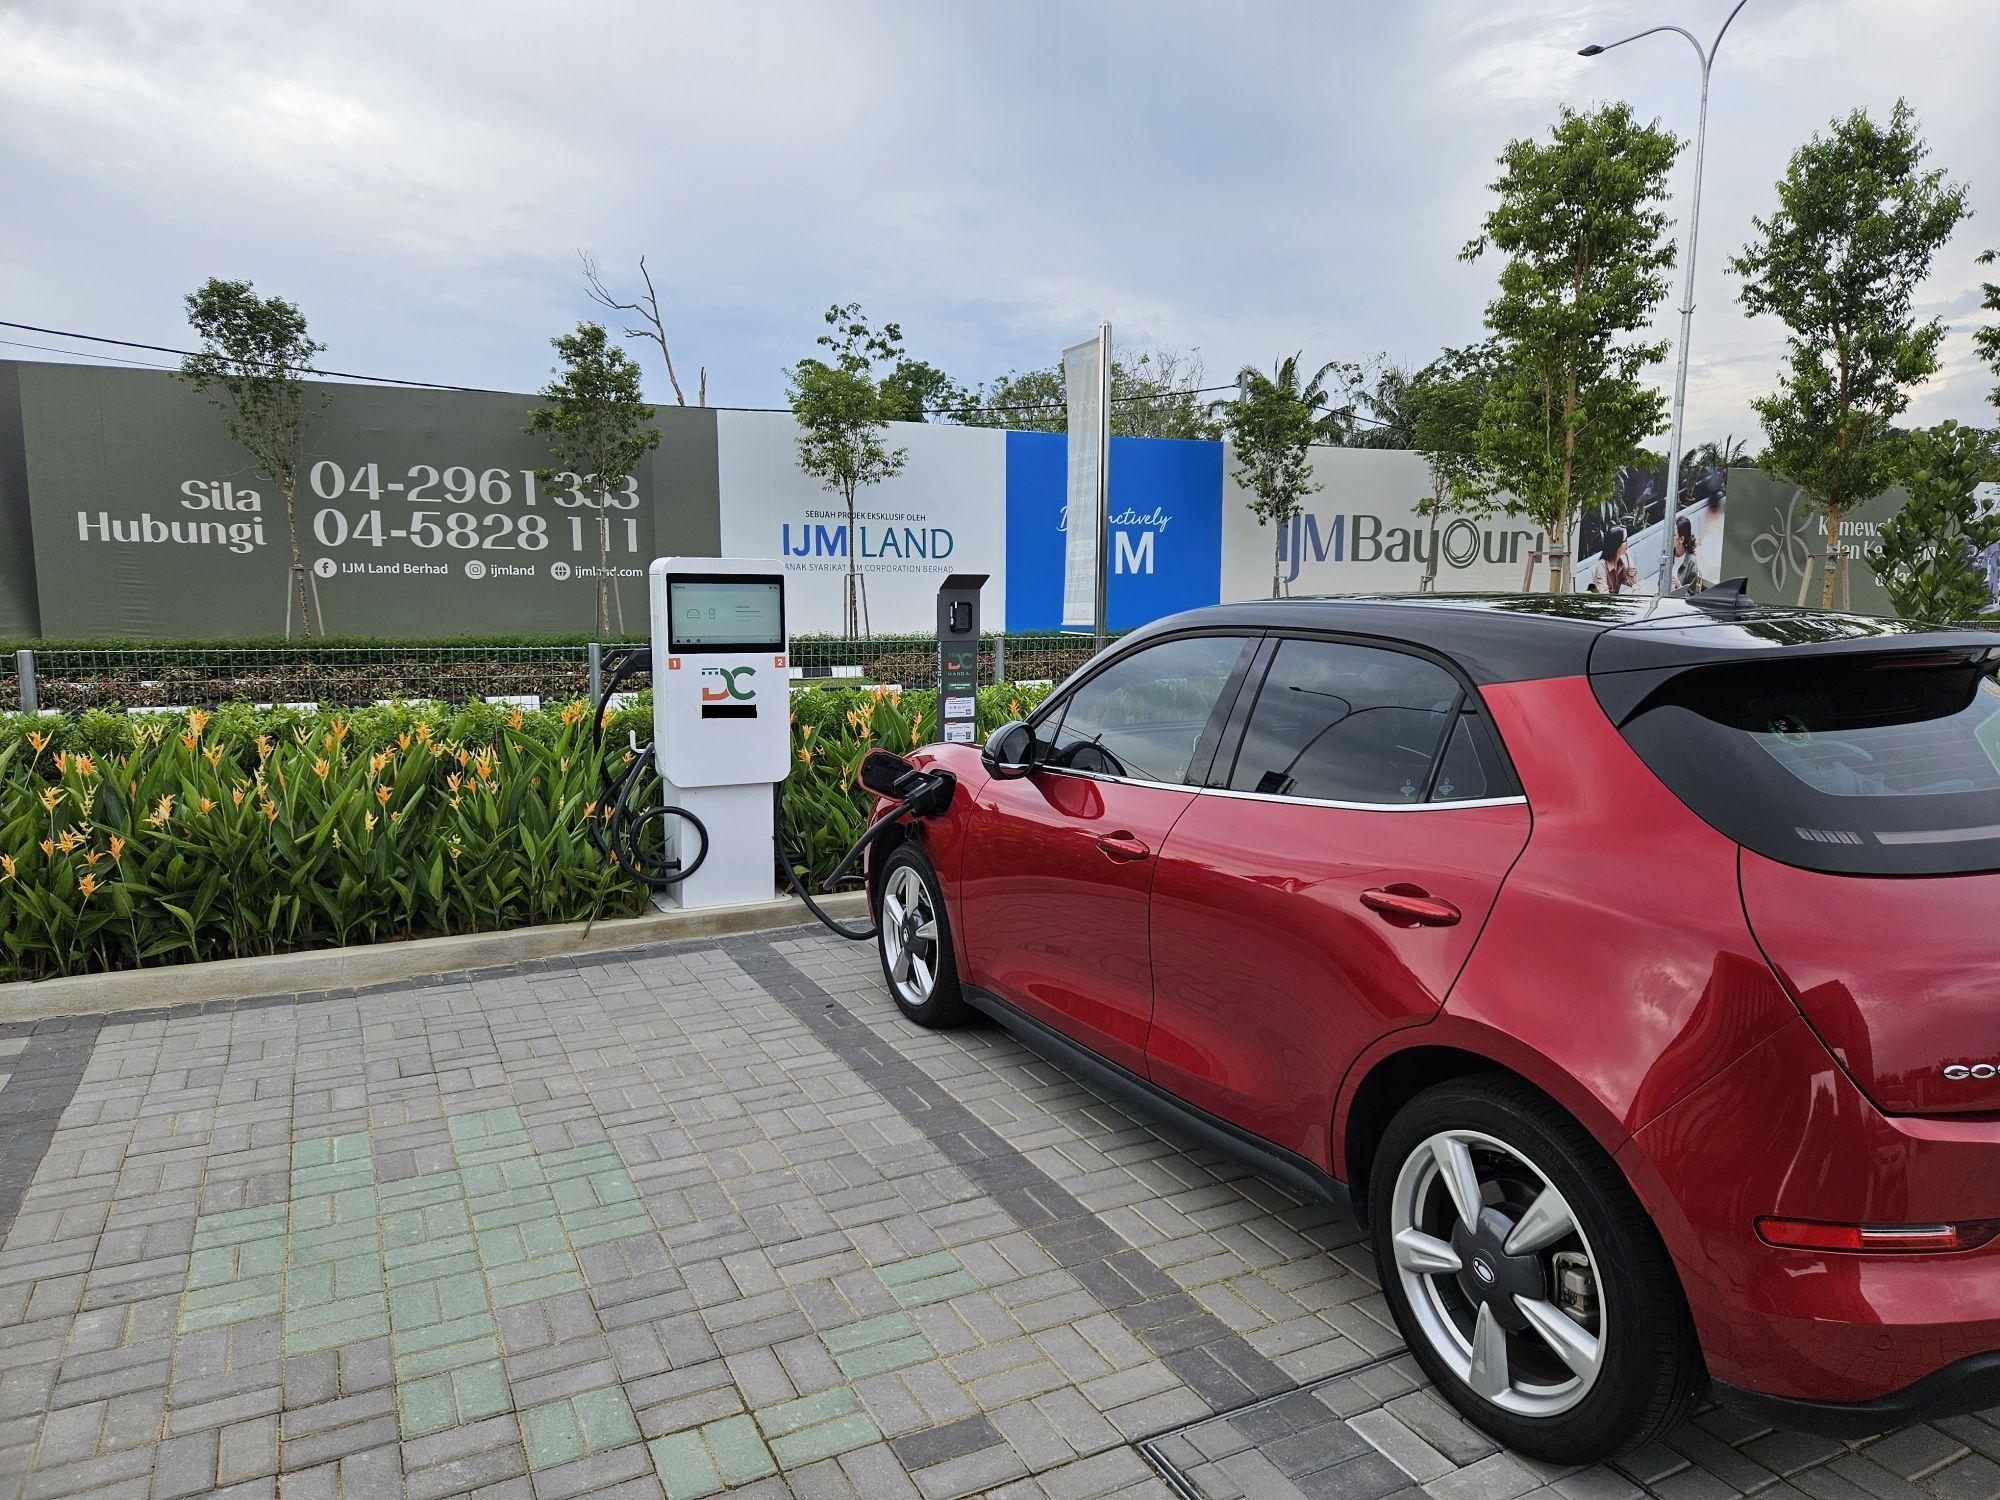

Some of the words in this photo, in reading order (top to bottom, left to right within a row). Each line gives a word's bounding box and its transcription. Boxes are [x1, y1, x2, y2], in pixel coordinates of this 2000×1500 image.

[180, 480, 261, 512] Sila
[553, 471, 640, 509] 333
[805, 510, 836, 519] SEBUAH
[837, 511, 866, 520] PROJEK
[867, 512, 905, 521] EKSKLUSIF
[906, 513, 926, 522] OLEH
[78, 512, 267, 553] Hubungi
[313, 508, 549, 550] 04-5828
[567, 516, 638, 552] 111
[782, 523, 848, 557] IJM
[860, 526, 954, 559] LAND
[342, 562, 366, 574] IJM
[368, 562, 400, 575] Land
[403, 563, 448, 575] Berhad
[490, 564, 535, 578] ijmland
[785, 563, 807, 571] ANAK
[809, 563, 846, 572] SYARIKAT
[865, 564, 921, 573] CORPORATION
[923, 565, 954, 573] BERHAD
[1943, 1063, 2000, 1080] GO
